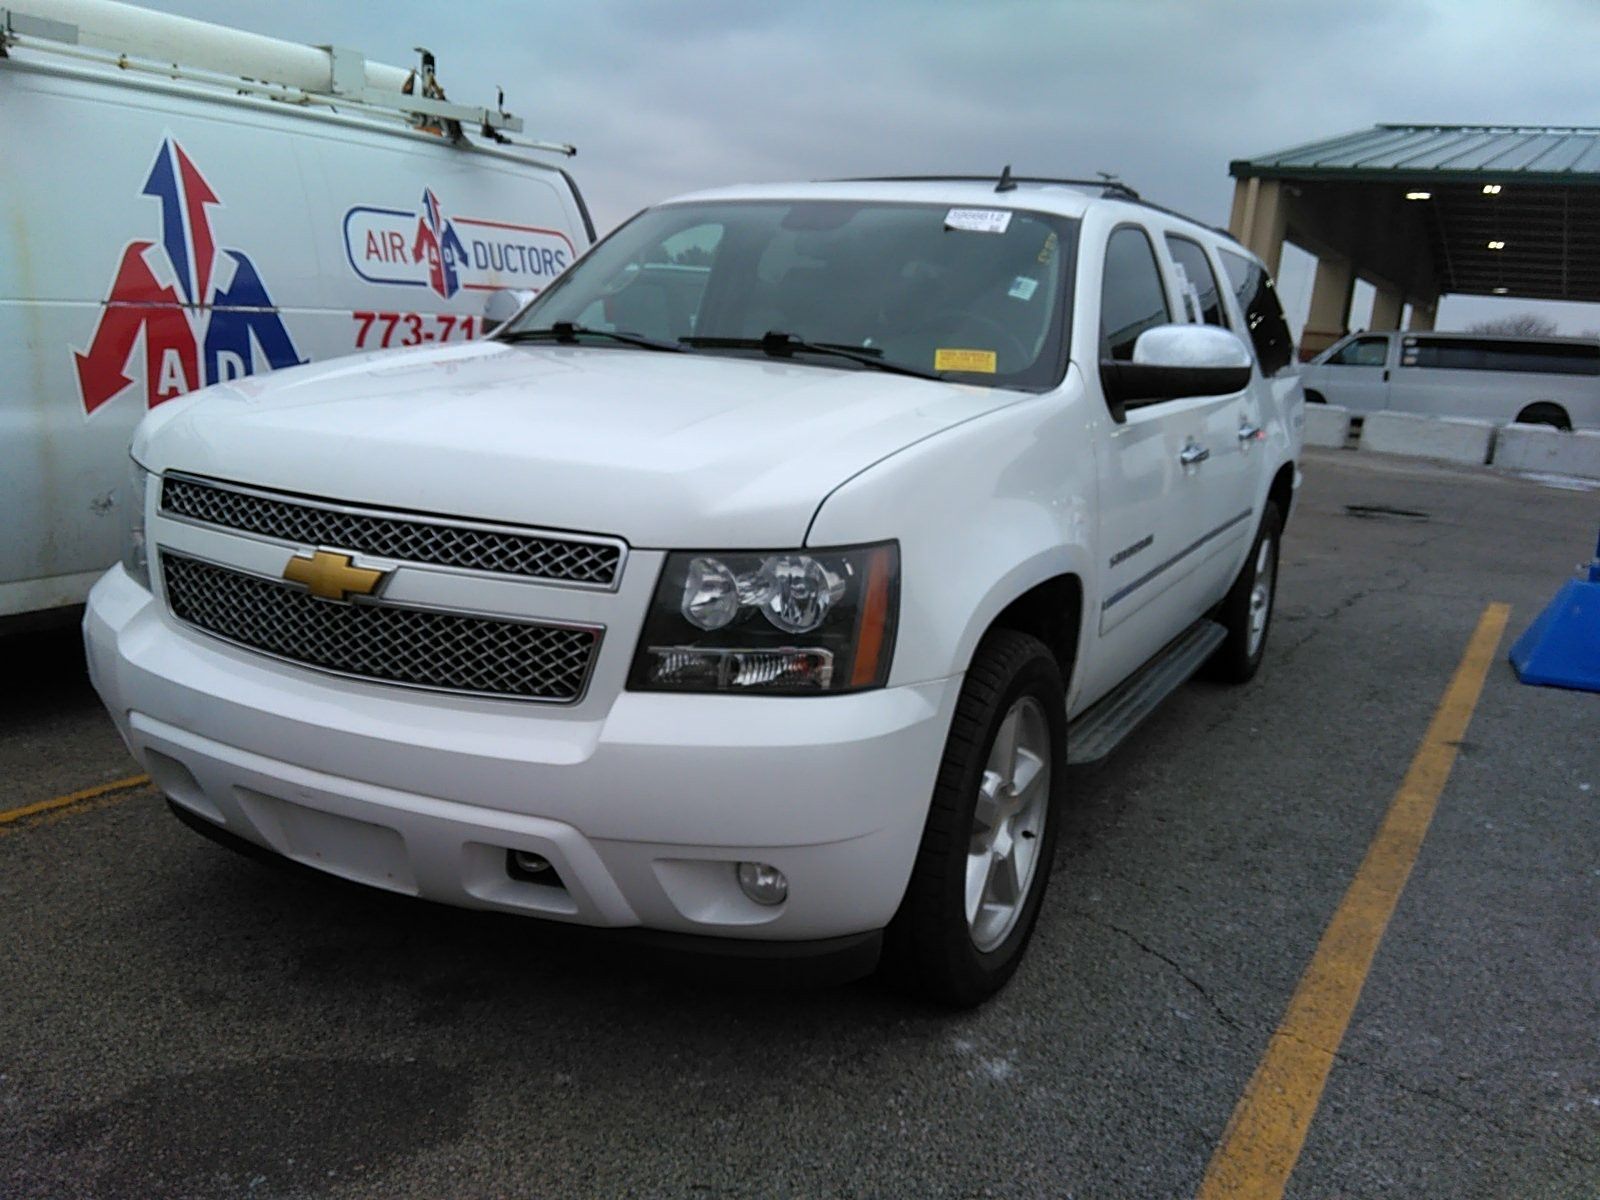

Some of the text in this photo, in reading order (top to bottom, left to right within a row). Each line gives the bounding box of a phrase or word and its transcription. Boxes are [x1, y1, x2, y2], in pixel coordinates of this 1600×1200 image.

[366, 229, 567, 277] AIR DUCTORS
[352, 311, 484, 349] 773-71
